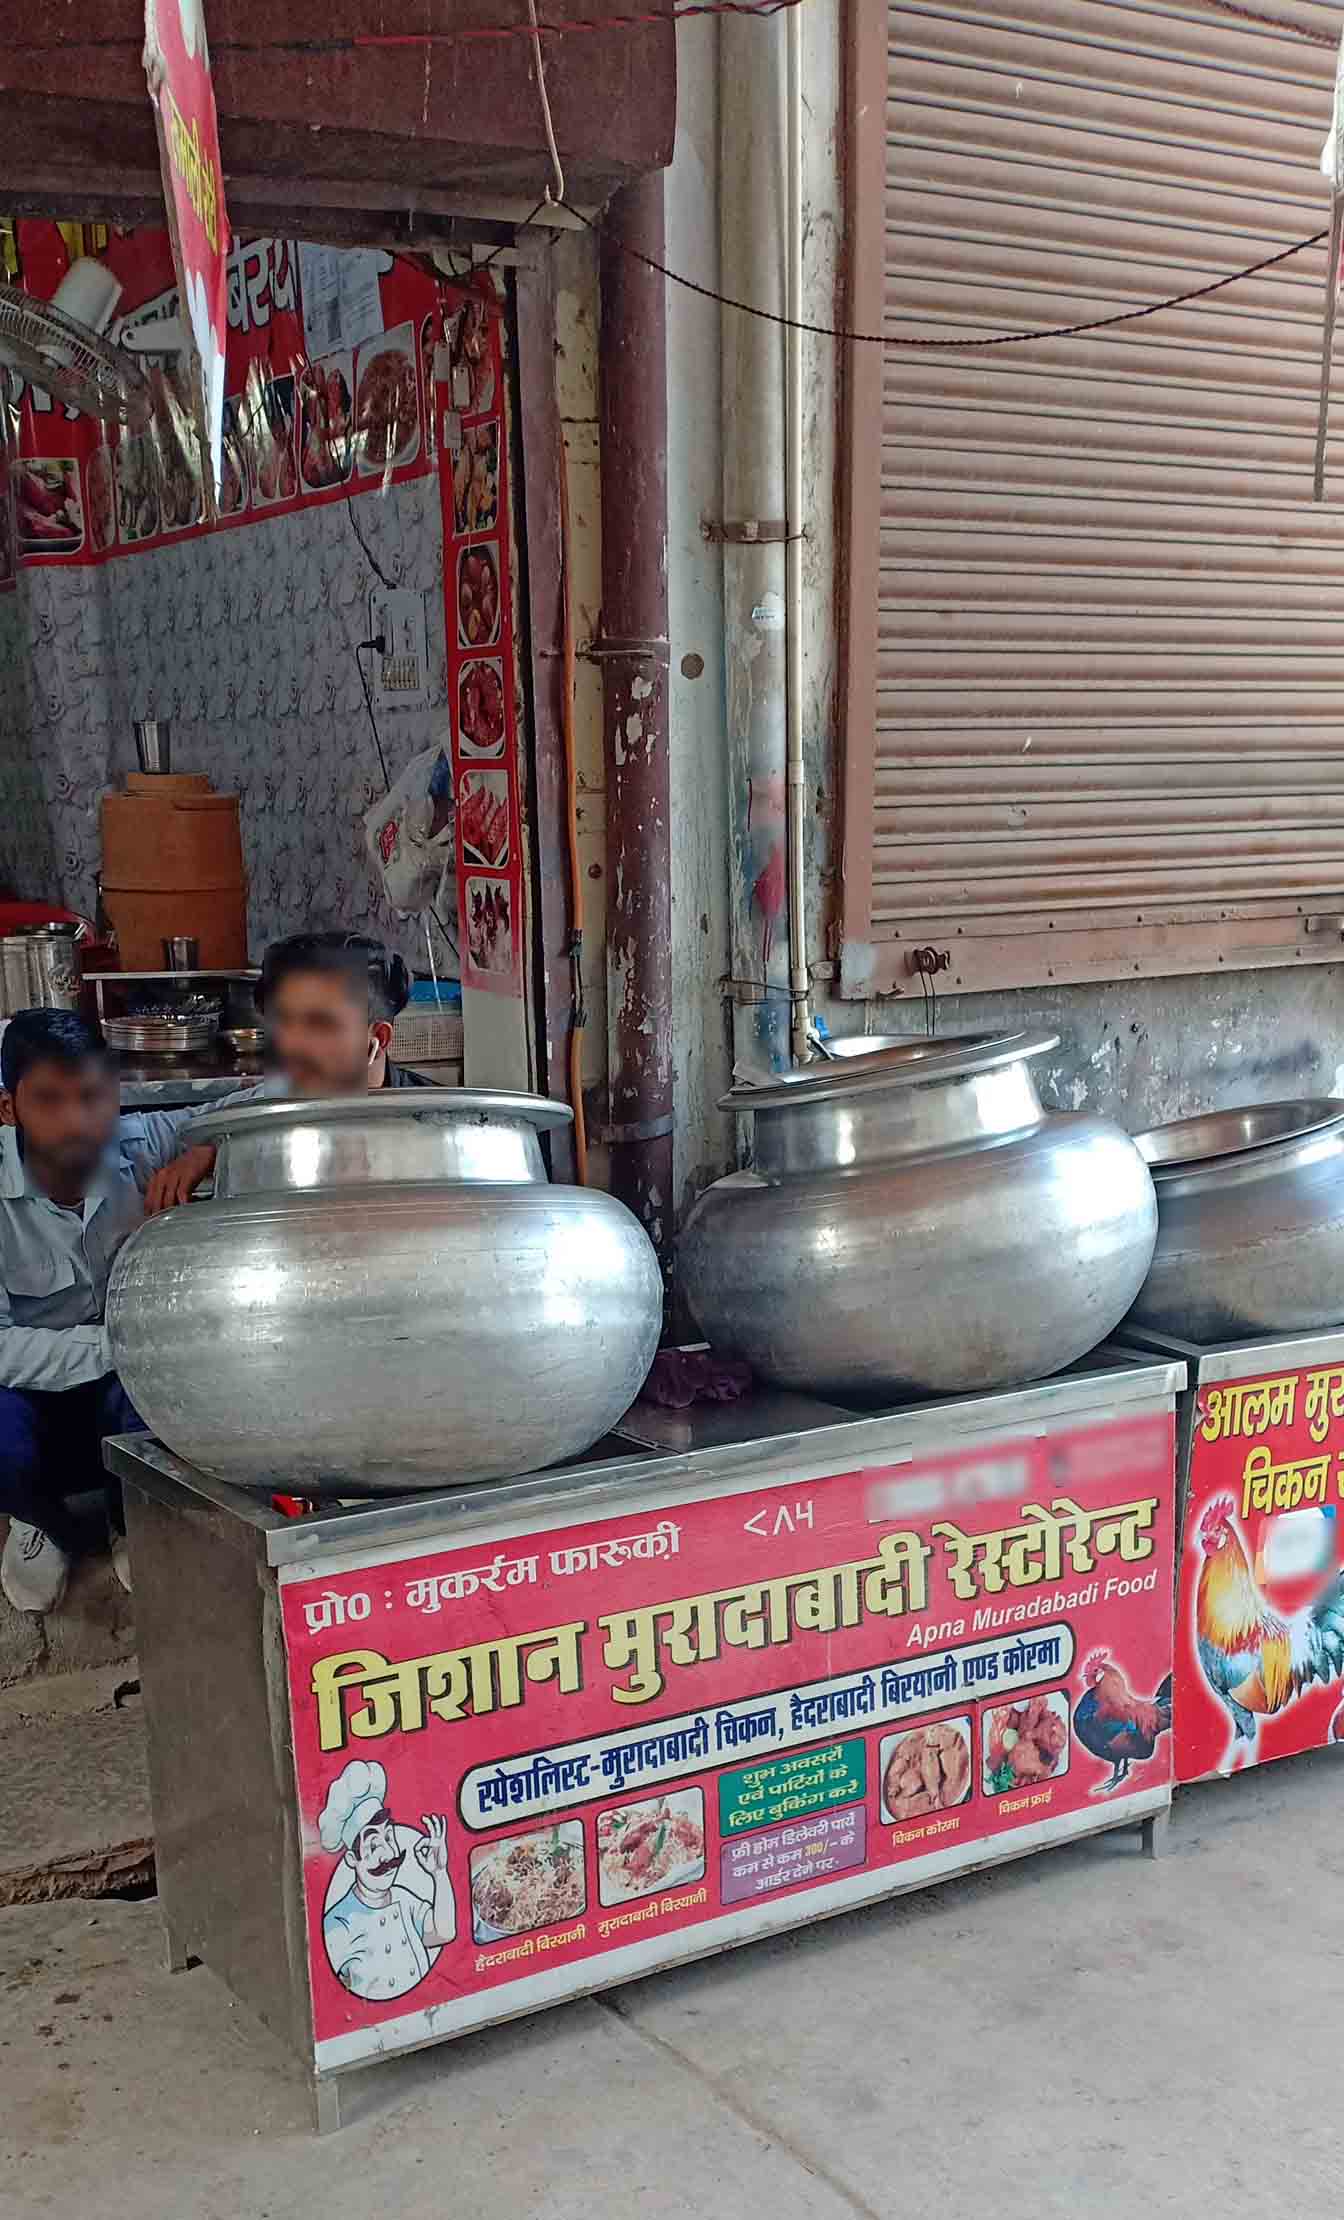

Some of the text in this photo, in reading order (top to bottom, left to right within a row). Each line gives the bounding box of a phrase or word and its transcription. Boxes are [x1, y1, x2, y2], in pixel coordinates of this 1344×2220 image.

[1201, 1376, 1299, 1441] आलम
[1241, 1446, 1332, 1518] चिकन
[405, 1554, 539, 1614] मुकर्रम
[312, 1498, 1158, 1752] जिशान मुरादाबादी रेस्टोरेन्ट
[906, 1569, 1158, 1649] Apna Muradabadi Food
[715, 1707, 784, 1750] चिकन,
[789, 1675, 875, 1730] हैदराबादी
[881, 1655, 957, 1708] बिरयानी
[961, 1652, 999, 1688] एण्ड
[1003, 1637, 1061, 1675] कोरमा
[743, 1745, 844, 1788] शुभ अवसरों
[830, 1764, 849, 1779] के
[729, 1808, 765, 1828] लिए
[769, 1791, 825, 1820] बुकिंग
[999, 1796, 1029, 1816] चिकन
[761, 1854, 774, 1870] से
[840, 1831, 856, 1846] के
[892, 1817, 960, 1848] चिकन कोरमा
[597, 1888, 707, 1938] मुरादाबादी बिरयानी
[536, 1924, 585, 1953] बिरयानी
